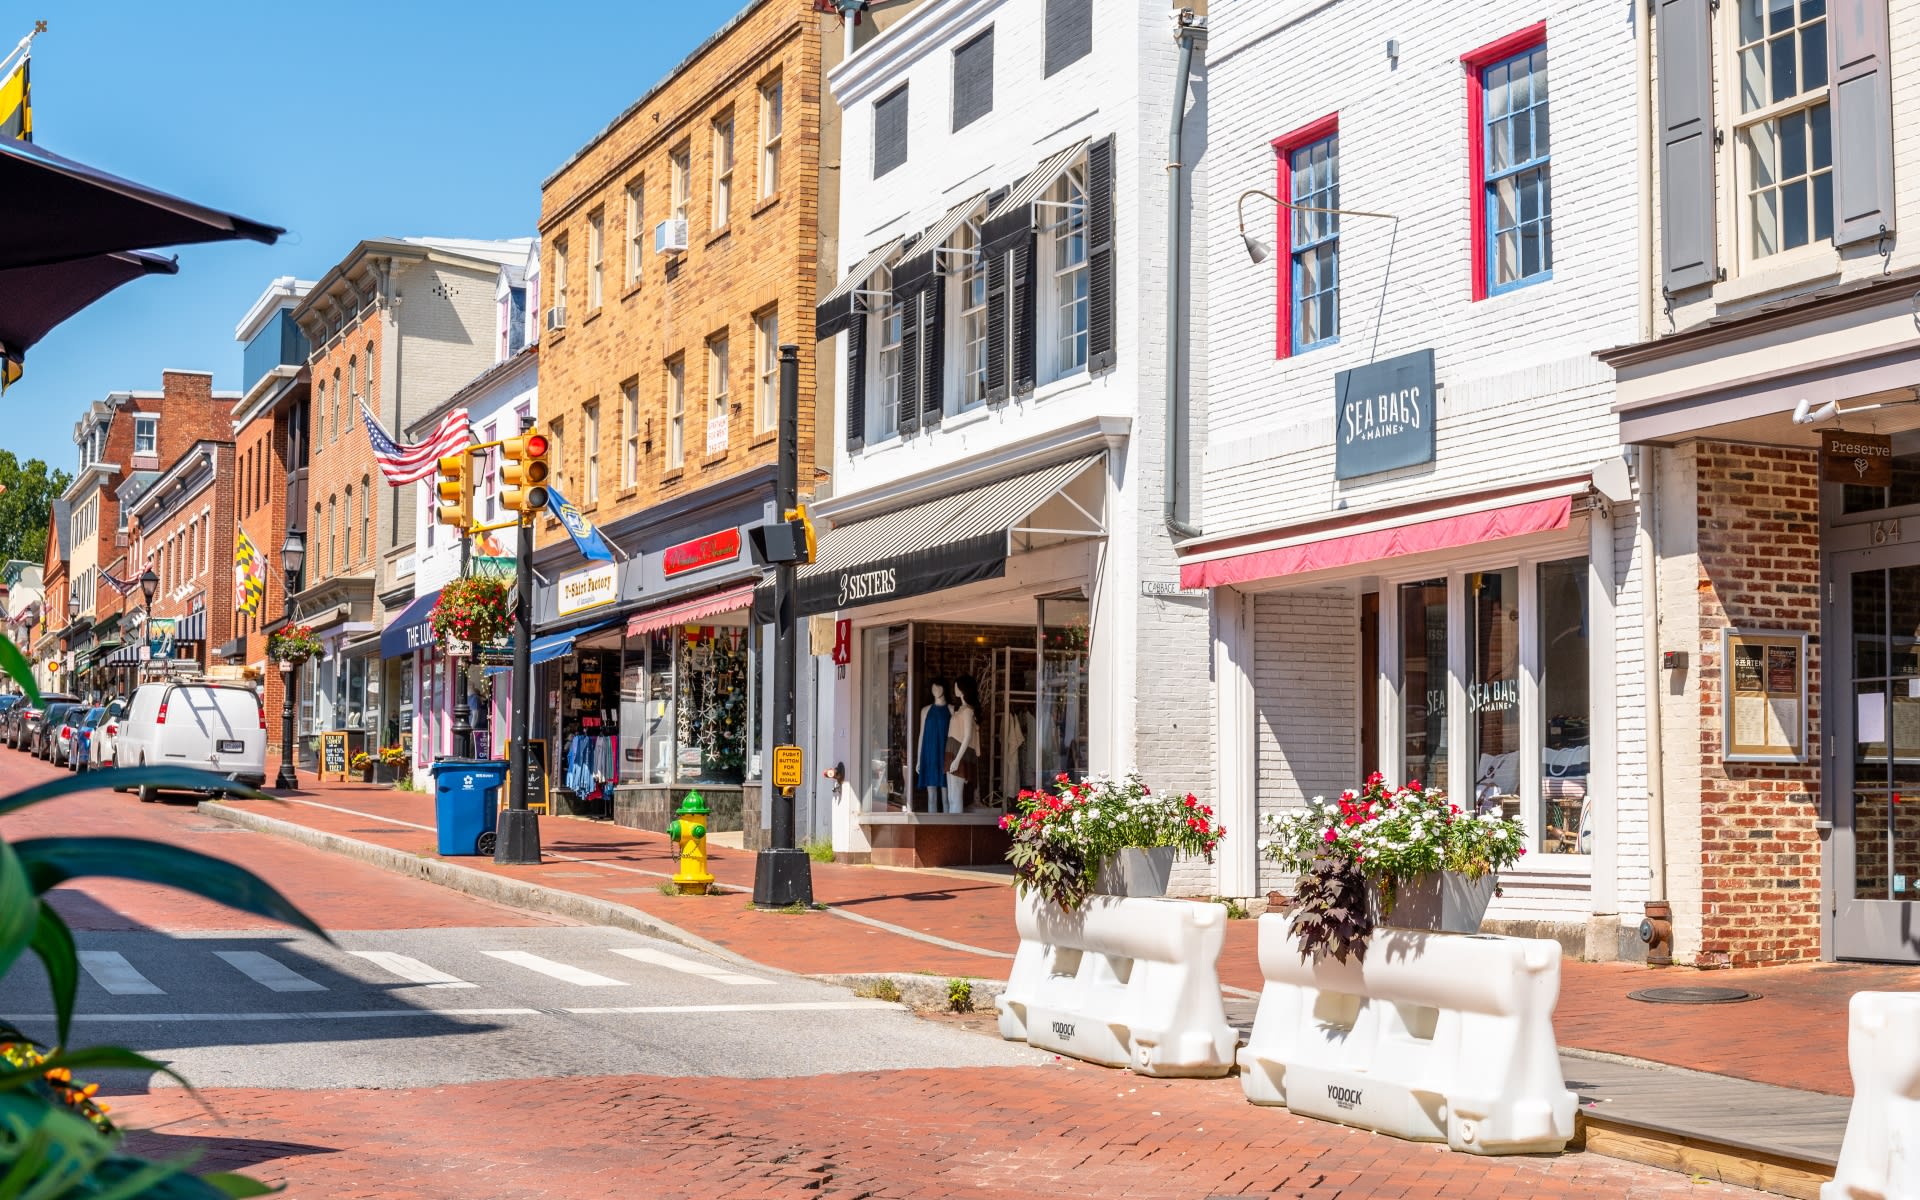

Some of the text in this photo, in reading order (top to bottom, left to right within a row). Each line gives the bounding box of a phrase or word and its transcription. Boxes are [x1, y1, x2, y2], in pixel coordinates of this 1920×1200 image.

[1345, 386, 1420, 445] SEA BAGS
[1367, 424, 1398, 441] MAINE
[1831, 440, 1890, 457] Preserve
[565, 576, 612, 600] T-Shirt Factory
[837, 568, 897, 606] 3 SISTERS
[406, 625, 420, 649] THE
[1427, 689, 1446, 717] SEA
[1469, 682, 1491, 714] SEA
[1484, 701, 1509, 712] MAINE
[1052, 1021, 1075, 1036] YODOCK
[1327, 1084, 1361, 1105] YODOCK
